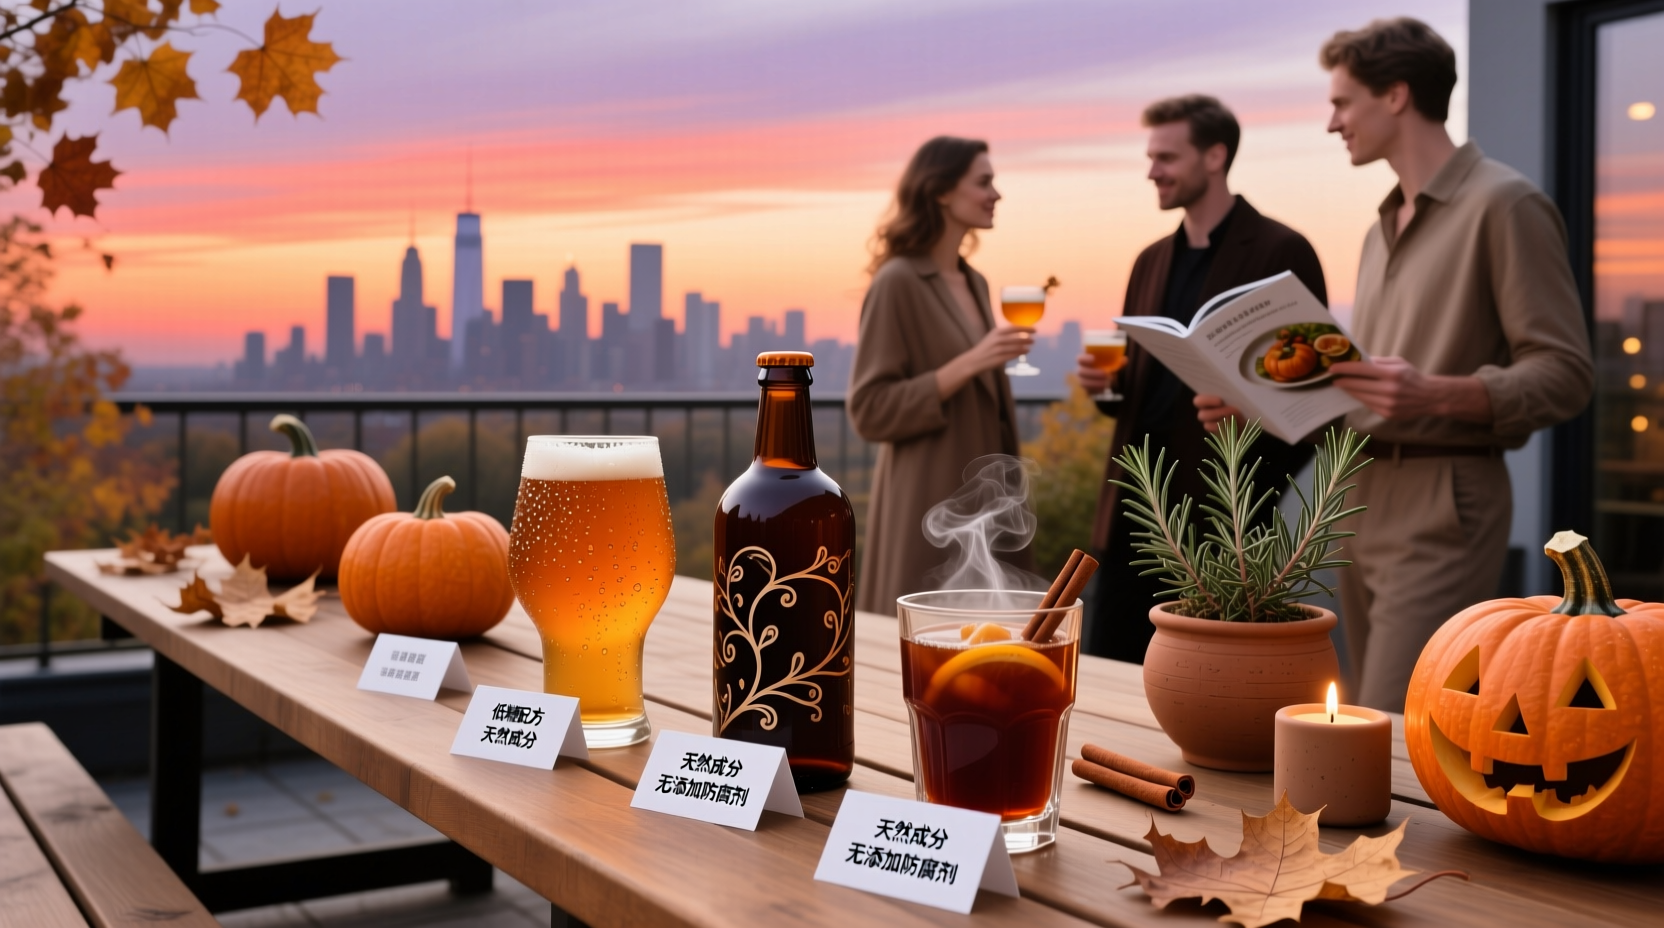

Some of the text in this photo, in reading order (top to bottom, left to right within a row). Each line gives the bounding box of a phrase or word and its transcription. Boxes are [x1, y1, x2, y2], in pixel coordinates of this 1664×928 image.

[680, 752, 743, 778] 天然成分
[874, 818, 949, 850] 天然成分
[845, 842, 959, 885] 无添加防腐剂
